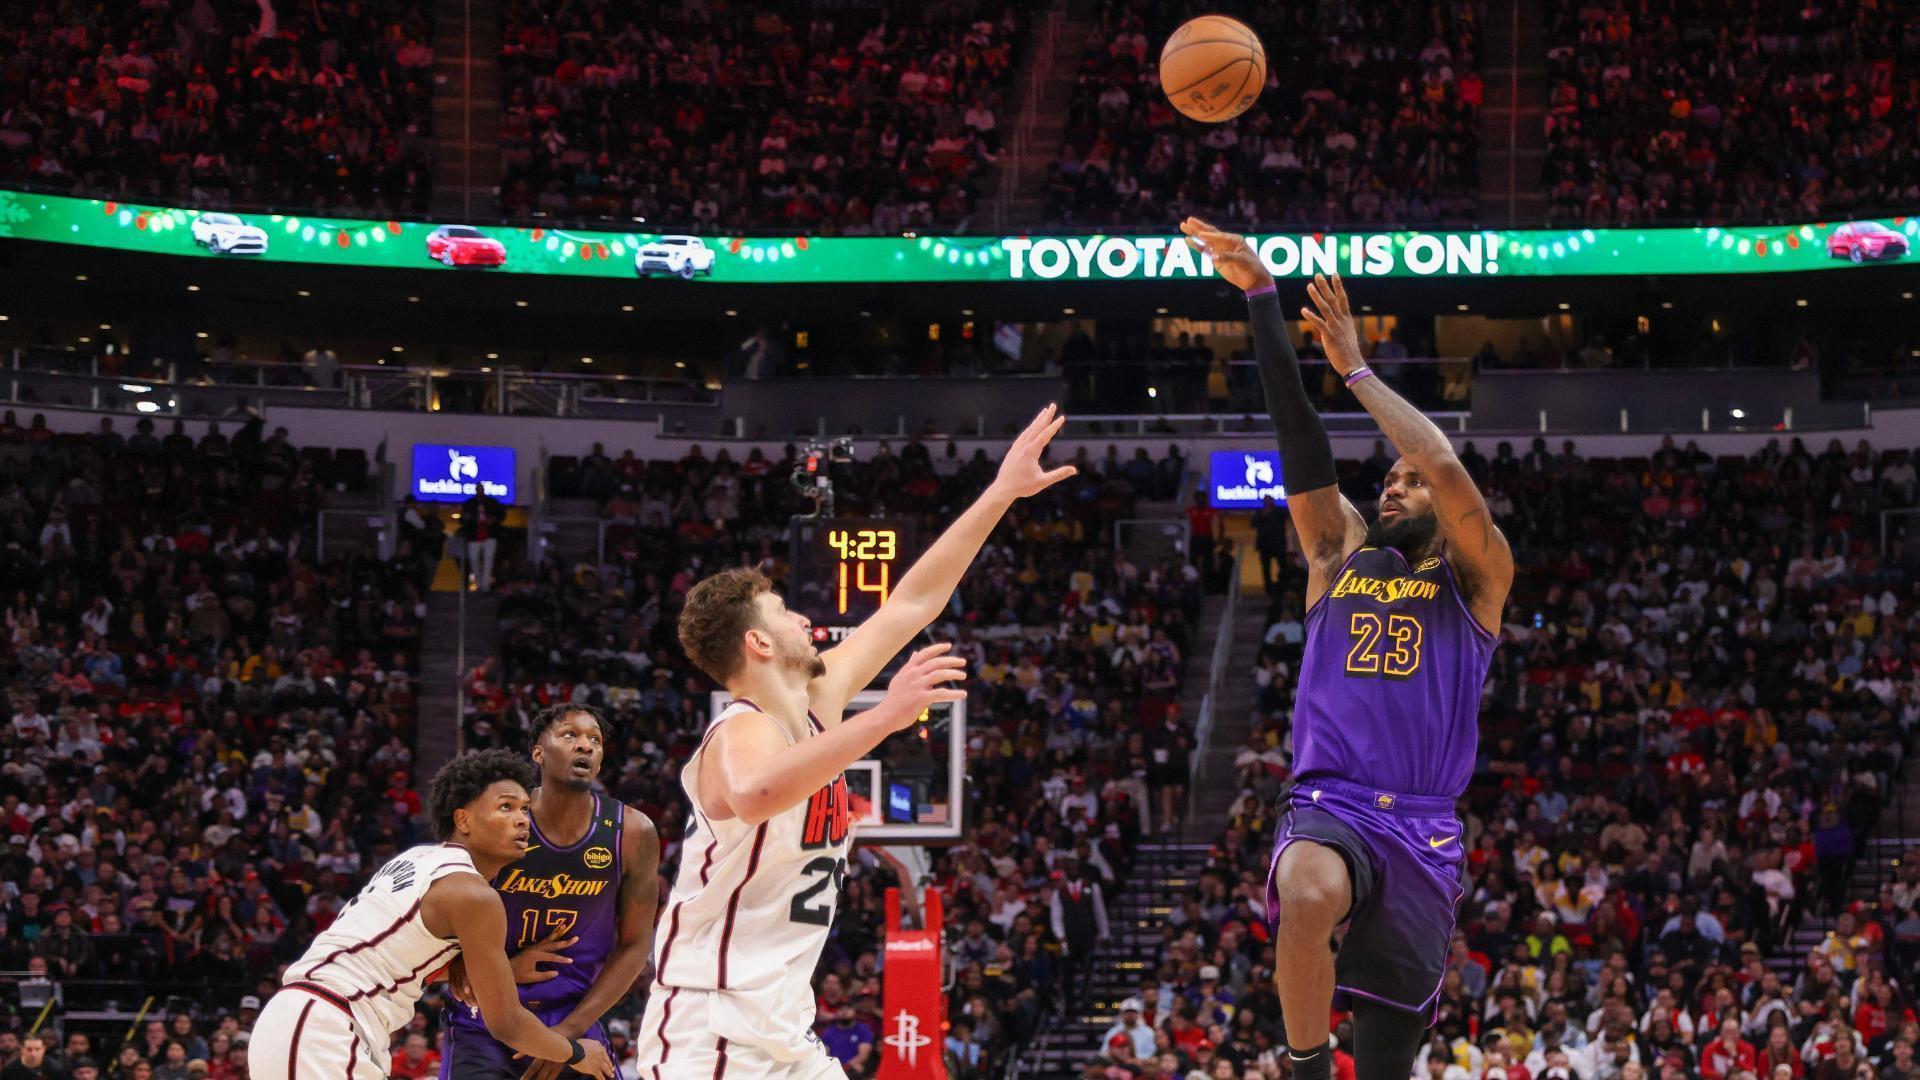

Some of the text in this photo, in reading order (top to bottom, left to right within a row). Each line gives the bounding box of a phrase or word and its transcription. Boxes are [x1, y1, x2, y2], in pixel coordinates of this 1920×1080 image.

[1350, 235, 1394, 277] IS
[1403, 235, 1498, 276] ON!
[829, 530, 896, 560] 4:23
[838, 561, 889, 615] 14
[1345, 613, 1422, 676] 23
[518, 908, 578, 949] 17
